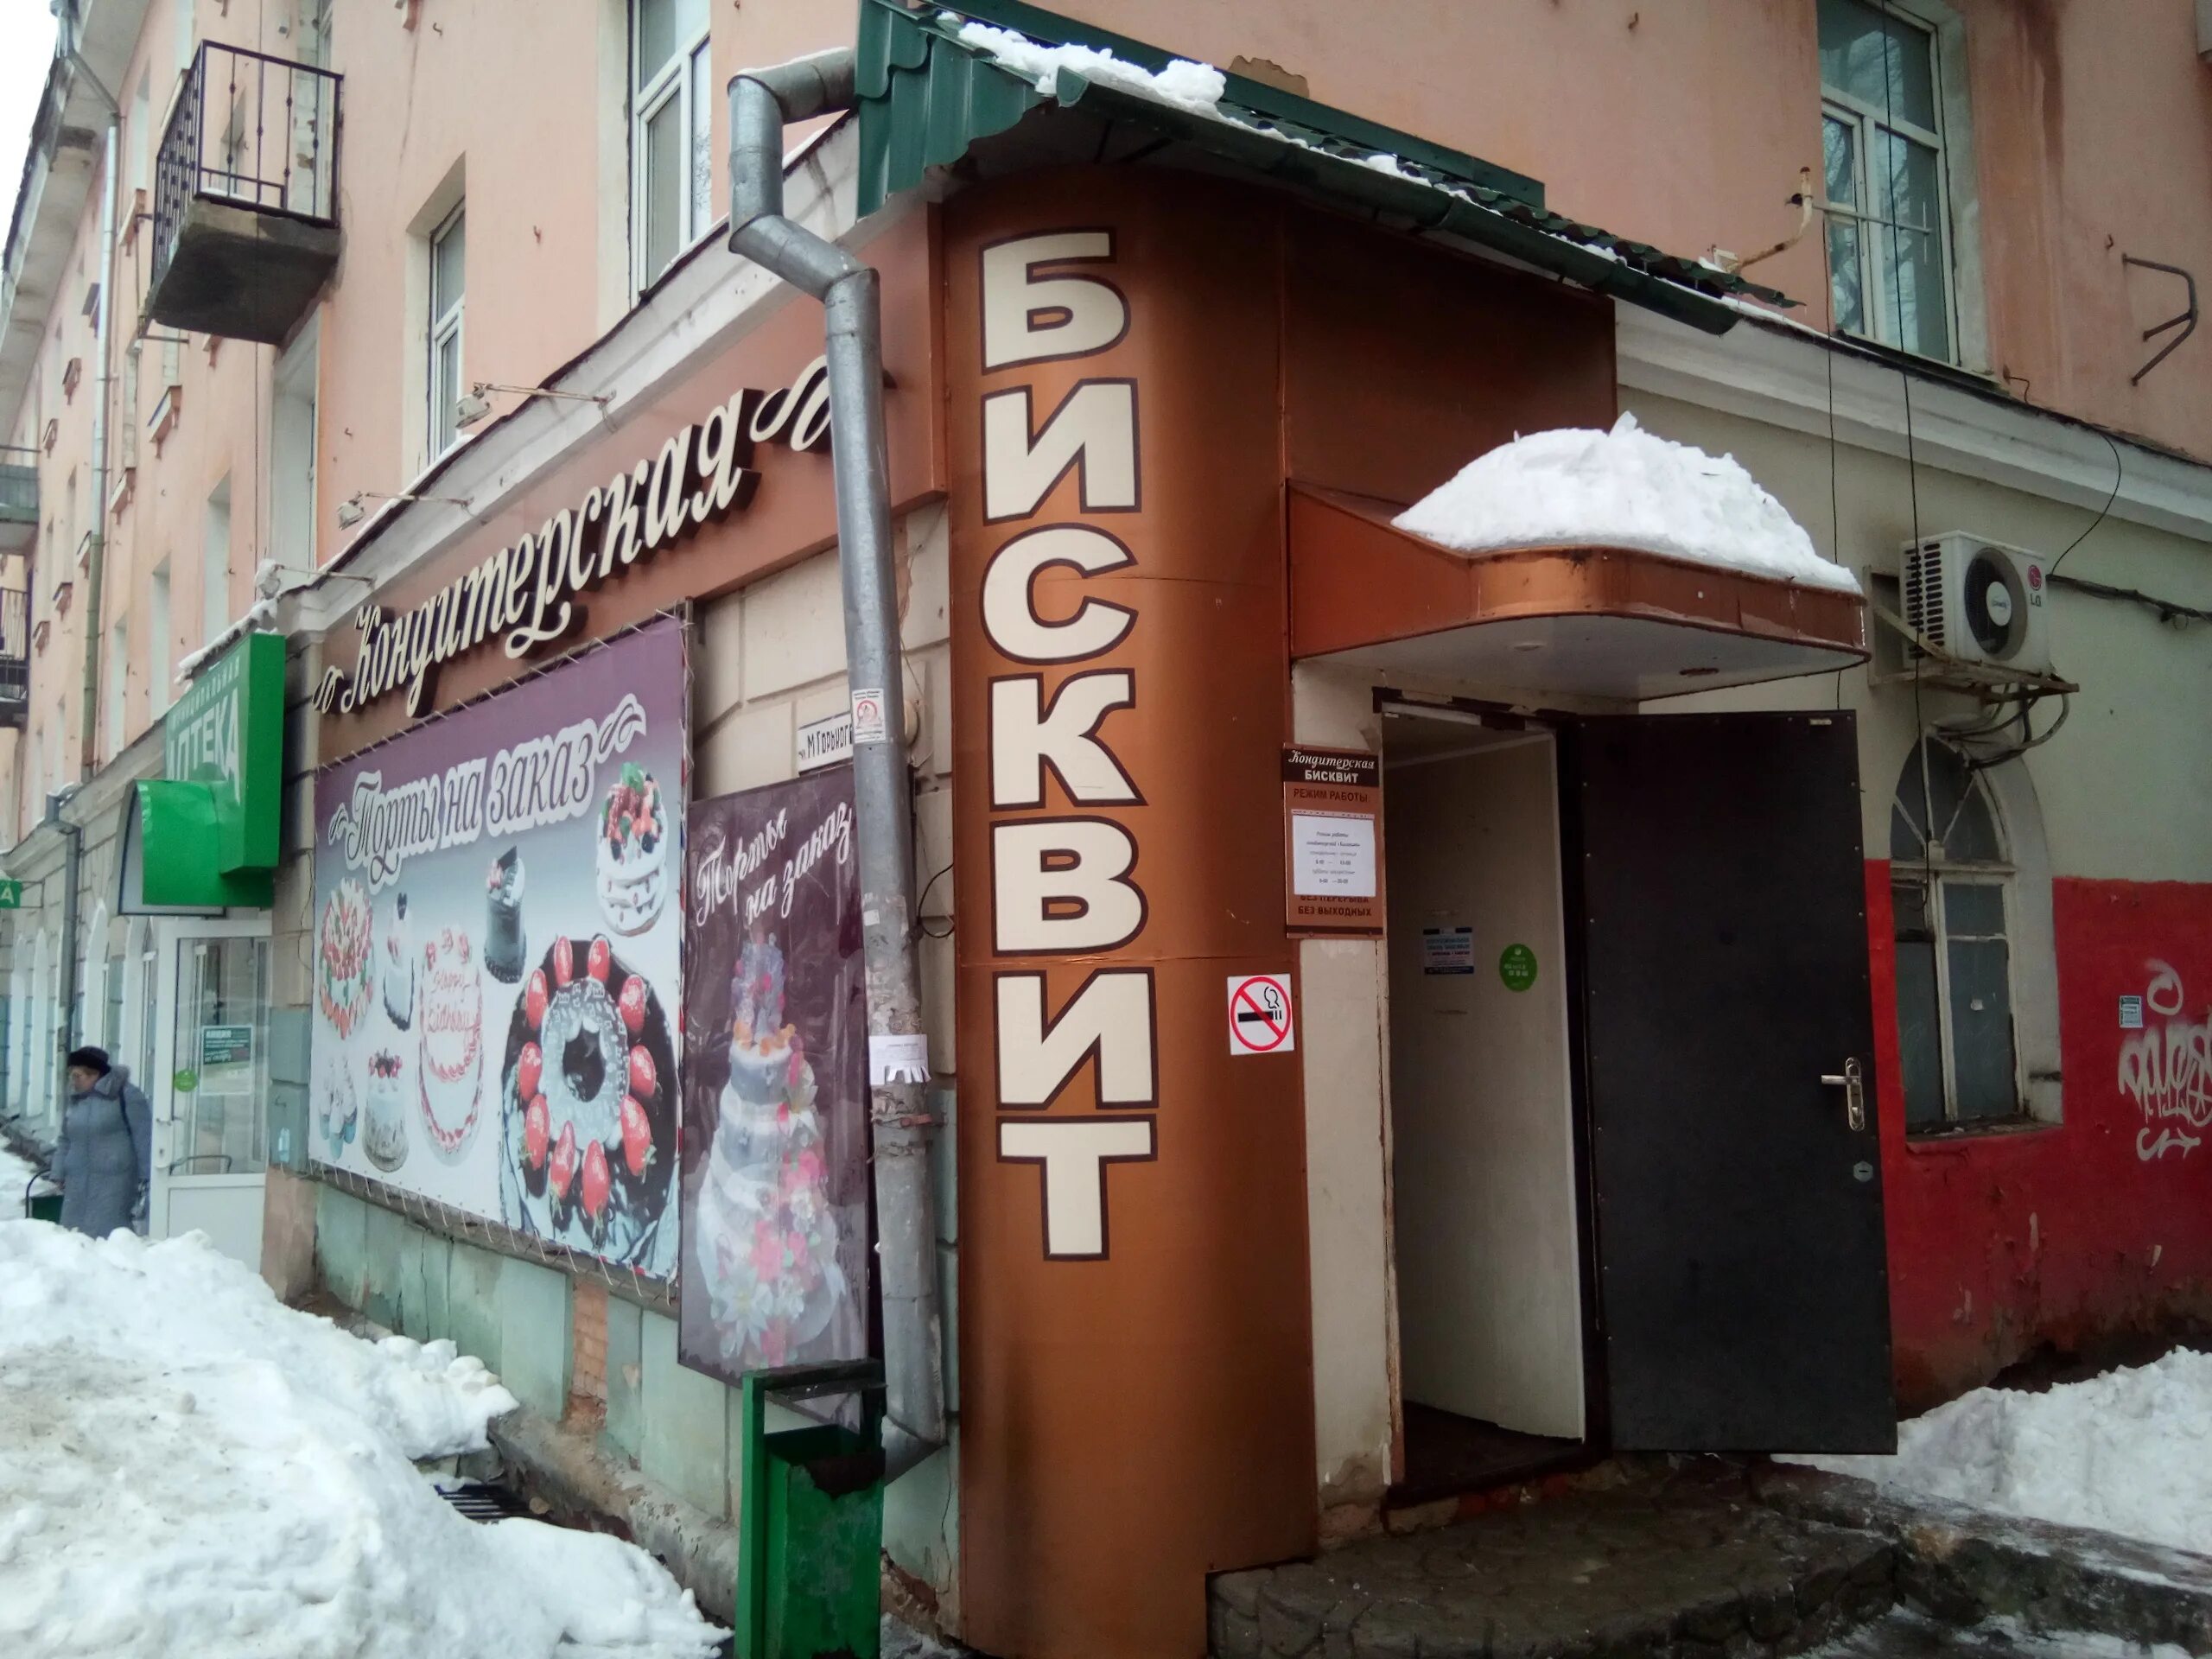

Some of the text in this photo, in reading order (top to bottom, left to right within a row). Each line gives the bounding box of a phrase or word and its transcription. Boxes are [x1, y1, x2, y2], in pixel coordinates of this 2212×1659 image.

[346, 388, 746, 718] Кондитерская
[166, 687, 241, 806] АПТЕКА
[978, 226, 1159, 1262] БИСКВИТ
[1287, 749, 1376, 771] Кондитерская
[1294, 788, 1369, 803] РЕЖИМ РАБОТЫ
[1305, 769, 1359, 784] БИСКВИТ
[346, 733, 594, 887] Торты на заказ
[696, 807, 787, 927] Торты
[745, 801, 853, 926] на заказ
[1298, 906, 1372, 917] БЕЗ ВЫХОДНЫХ
